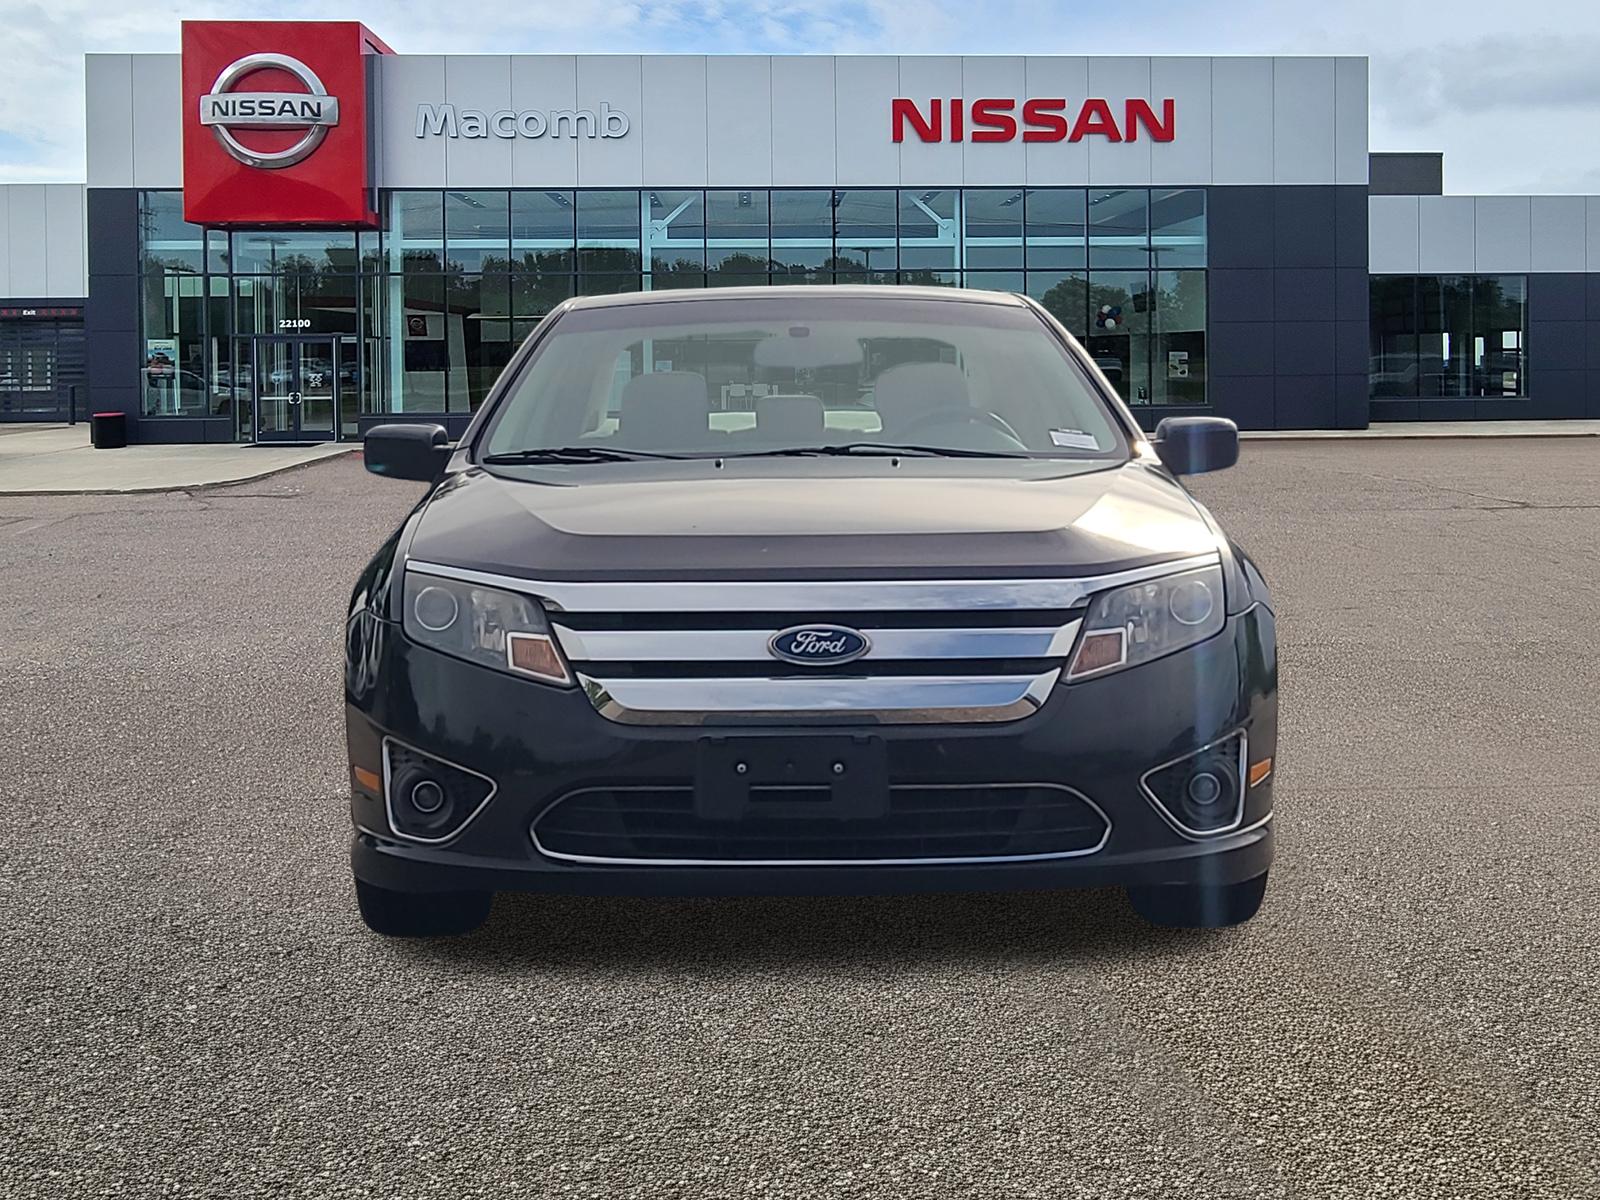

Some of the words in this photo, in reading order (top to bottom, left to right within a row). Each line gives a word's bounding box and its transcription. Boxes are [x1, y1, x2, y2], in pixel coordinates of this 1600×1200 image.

[211, 100, 322, 118] NISSAN
[415, 102, 630, 139] Macomb
[891, 98, 1176, 143] NISSAN
[279, 319, 311, 328] 22100
[790, 630, 847, 654] Ford
